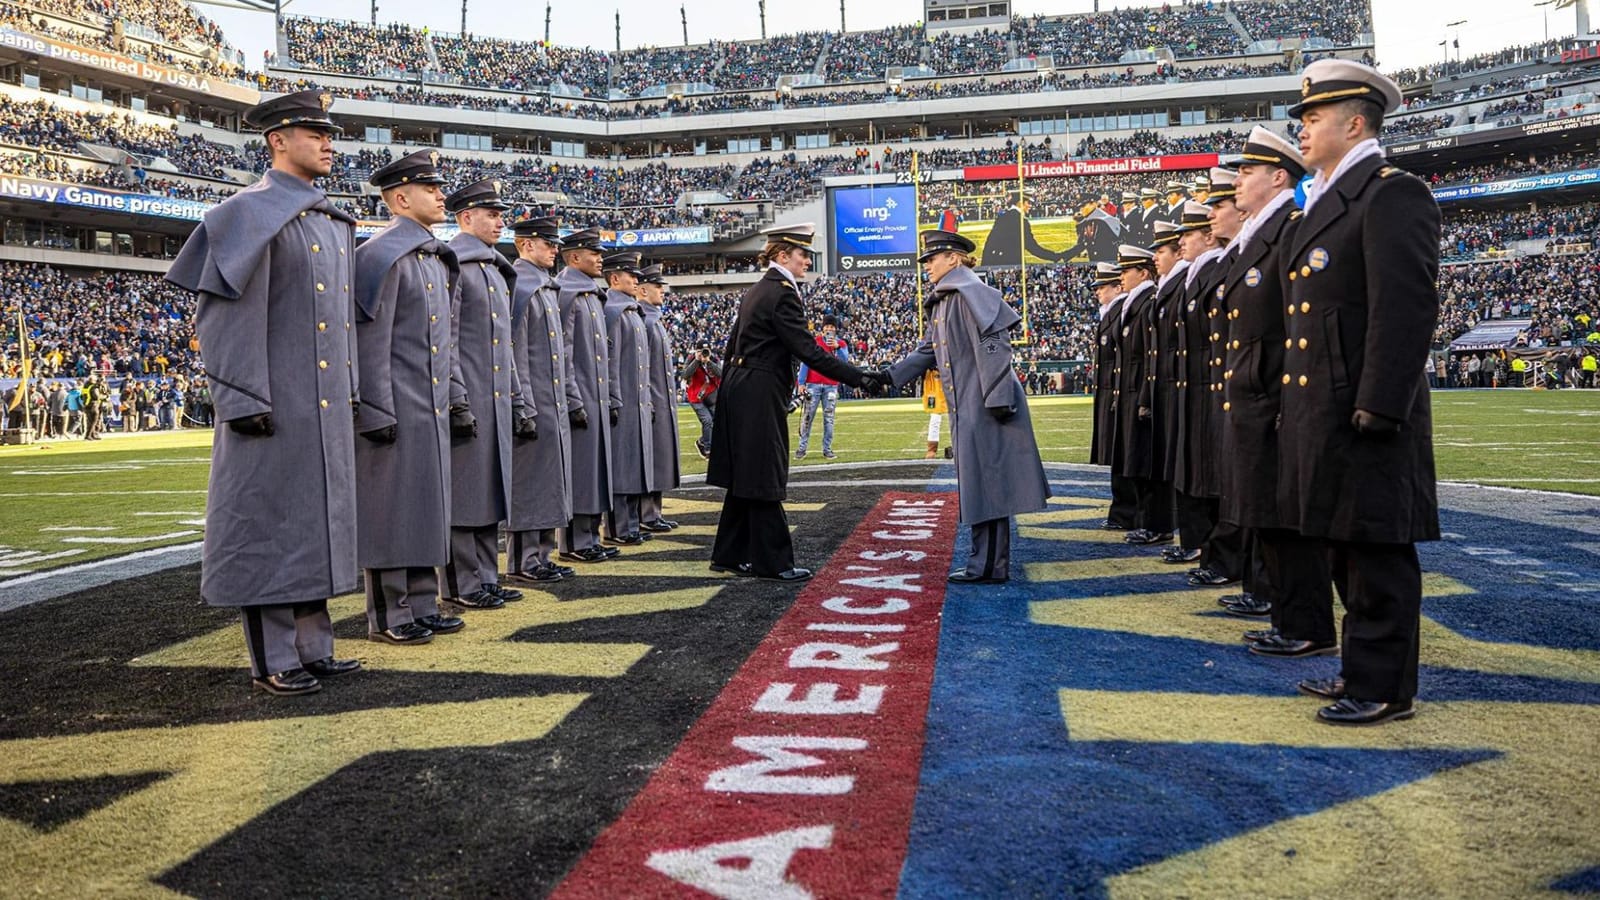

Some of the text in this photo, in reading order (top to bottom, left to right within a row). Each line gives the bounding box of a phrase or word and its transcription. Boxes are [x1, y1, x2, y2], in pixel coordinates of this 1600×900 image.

[0, 32, 210, 92] ame presented by USAA
[1030, 157, 1161, 176] Lincoln Financial Field
[1, 176, 58, 202] Navy
[65, 186, 125, 209] Game
[1459, 188, 1469, 196] to
[1471, 185, 1486, 194] the
[1511, 174, 1565, 189] Army-Navy
[1567, 172, 1597, 182] Game
[643, 230, 702, 243] #ARMYNAVY
[857, 258, 911, 268] socios.com
[872, 499, 946, 540] GAME
